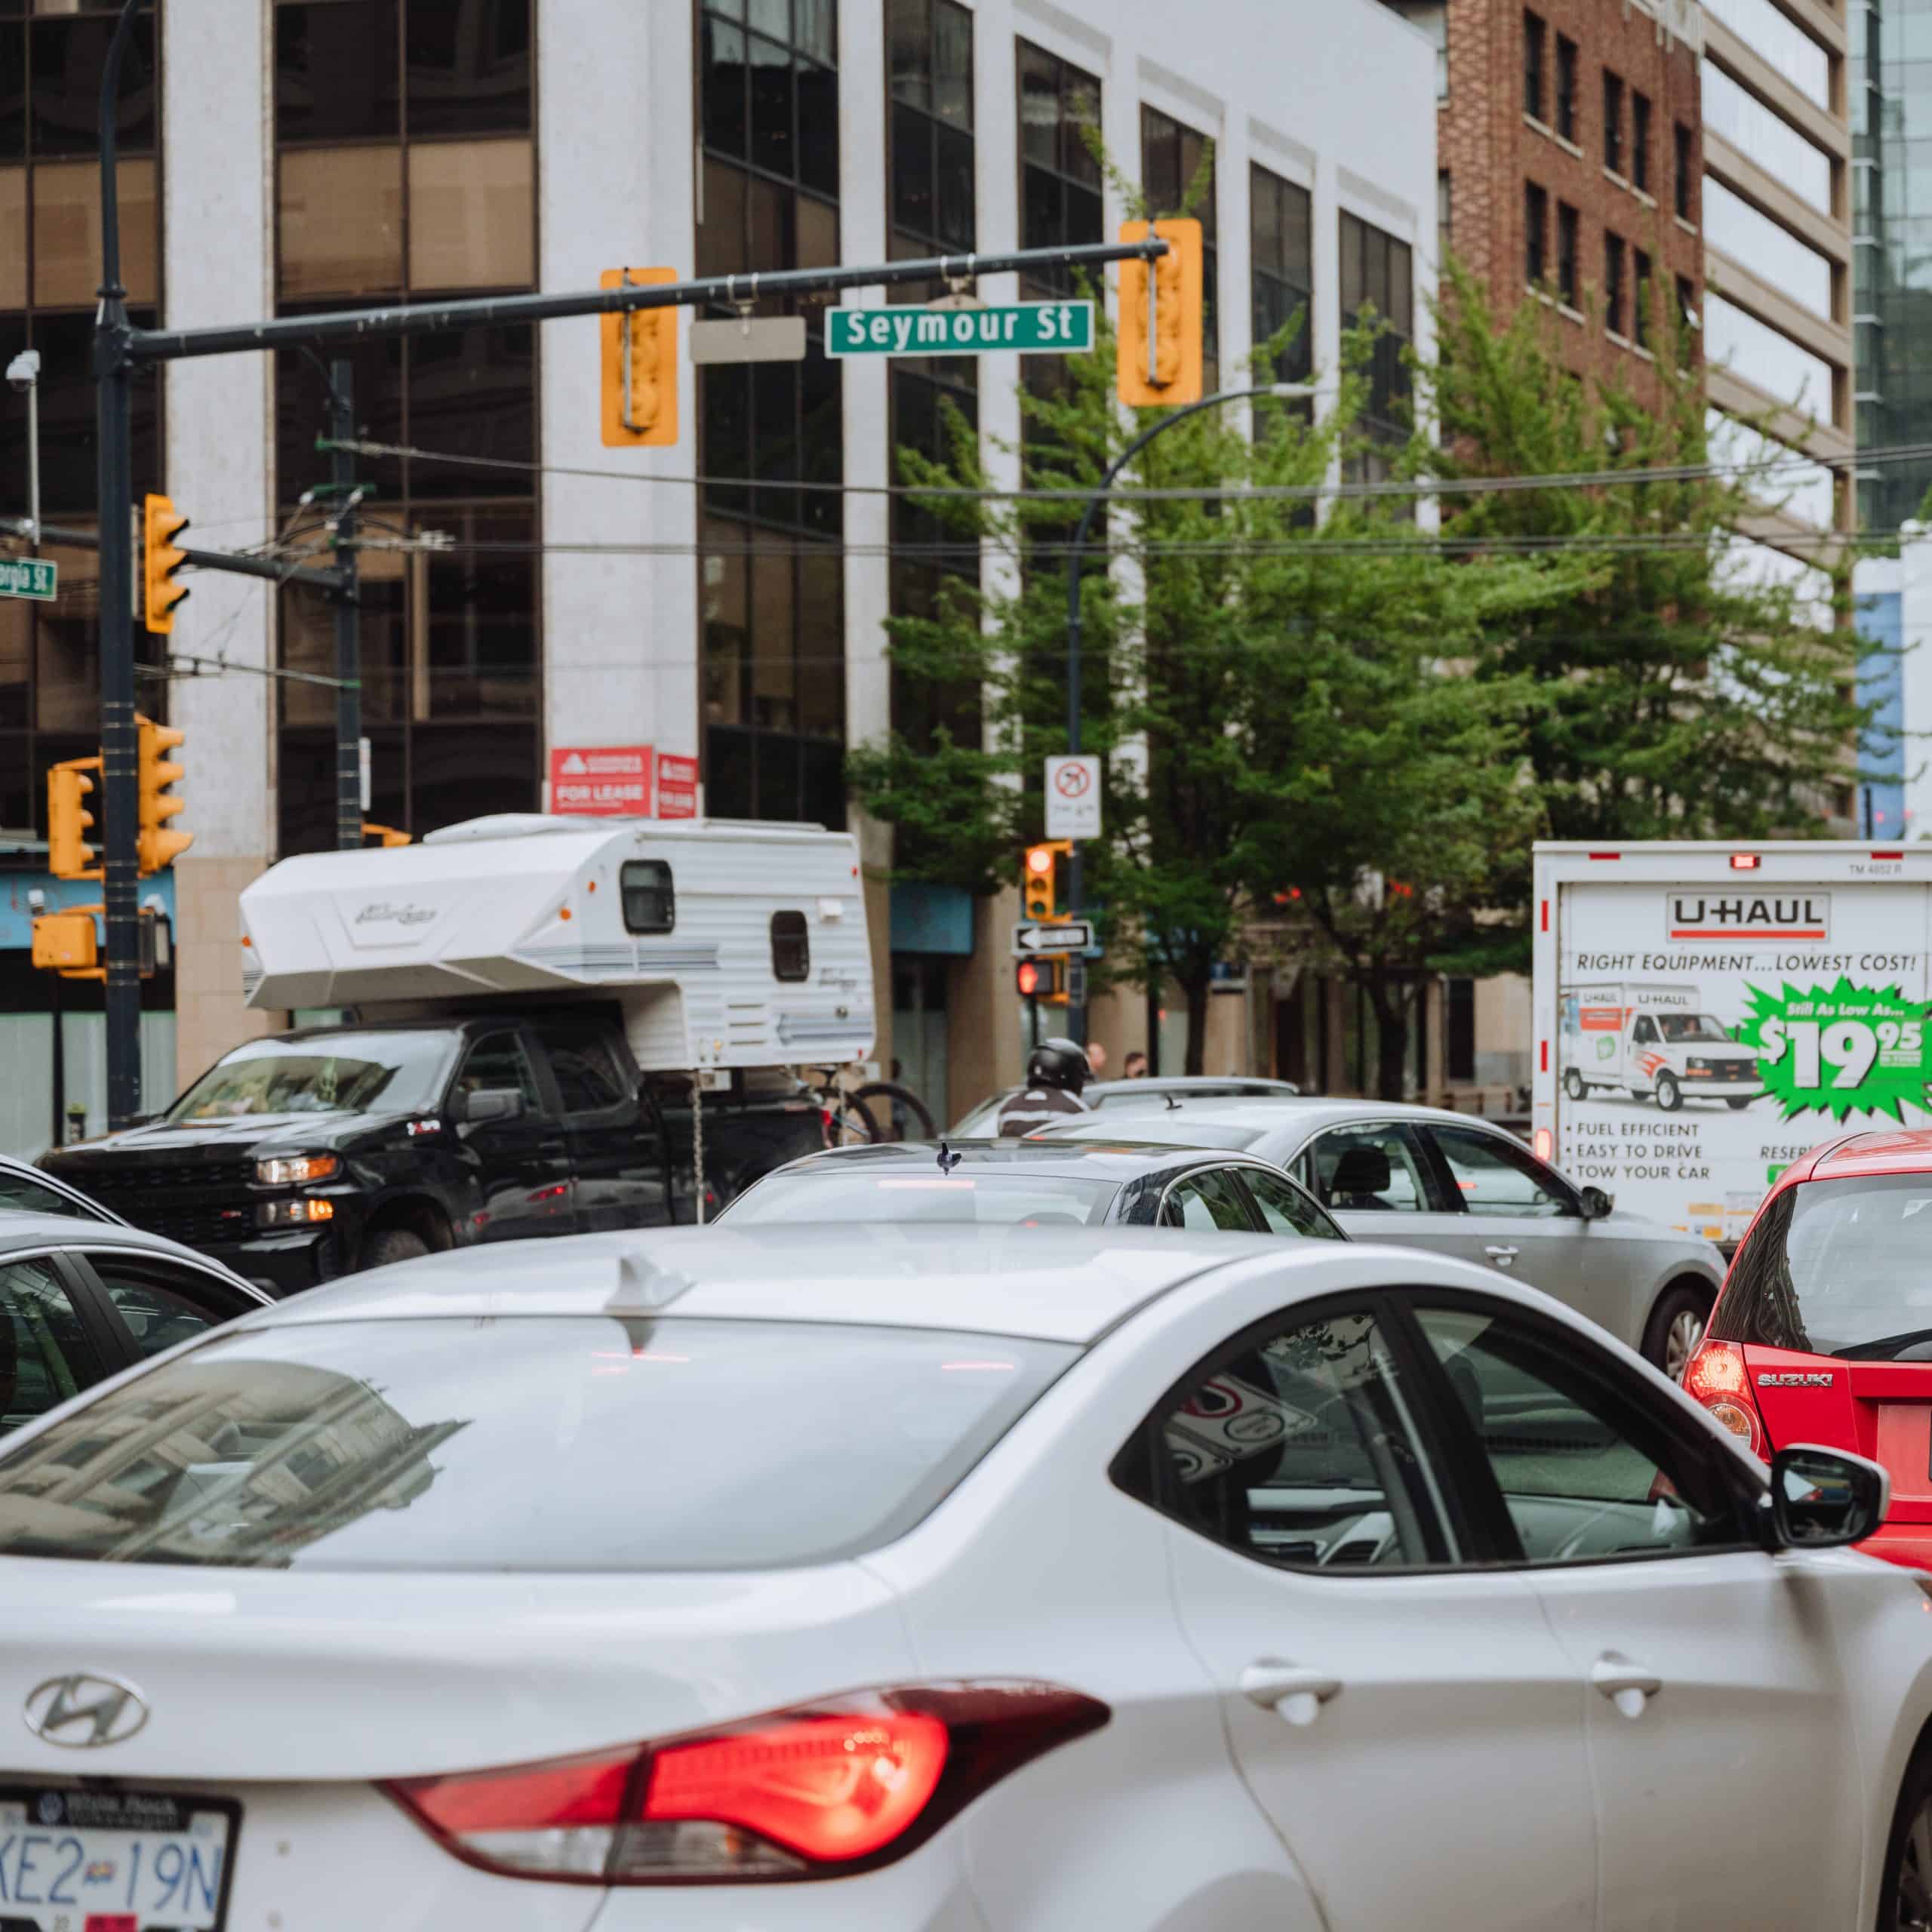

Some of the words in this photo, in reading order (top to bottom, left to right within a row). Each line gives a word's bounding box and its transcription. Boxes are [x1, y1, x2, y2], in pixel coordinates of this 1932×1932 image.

[847, 311, 1019, 351] Seymour
[1036, 306, 1073, 340] St
[34, 564, 47, 591] St
[556, 785, 590, 800] FOR
[592, 785, 644, 800] LEASE
[1674, 899, 1823, 924] U-HAUL
[1577, 954, 1635, 971] RIGHT
[1860, 955, 1916, 971] COST!
[1786, 1001, 1814, 1016] Still
[1816, 1002, 1836, 1016] As
[1838, 1002, 1870, 1016] Low
[1577, 1122, 1614, 1136] FUEL
[1621, 1122, 1700, 1137] EFFICIENT
[1577, 1144, 1618, 1158] EASY
[1625, 1144, 1647, 1158] TO
[1654, 1143, 1703, 1158] DRIVE
[1761, 1146, 1814, 1159] RESER
[1577, 1165, 1617, 1178] TOW
[1623, 1165, 1670, 1178] YOUR
[1677, 1167, 1710, 1179] CAR
[1757, 1374, 1833, 1386] SUZUKI
